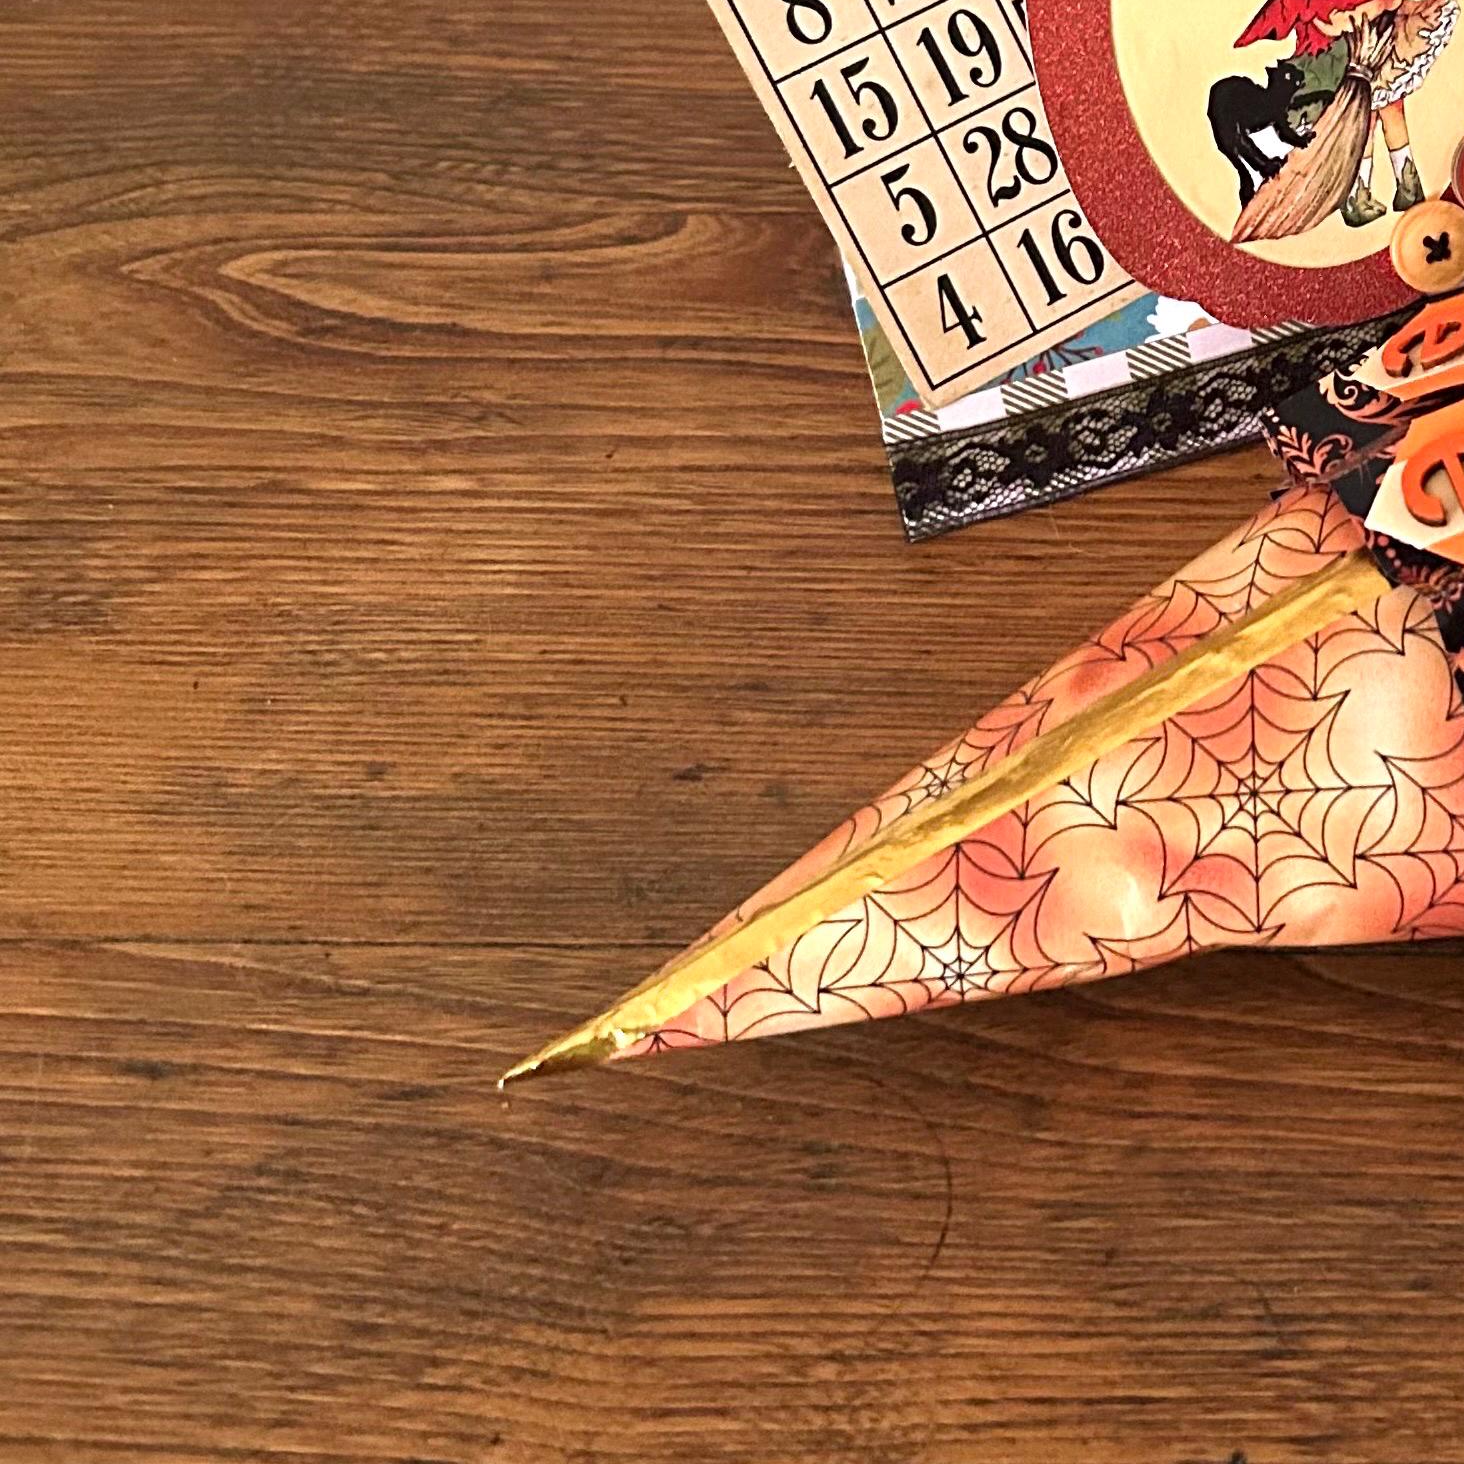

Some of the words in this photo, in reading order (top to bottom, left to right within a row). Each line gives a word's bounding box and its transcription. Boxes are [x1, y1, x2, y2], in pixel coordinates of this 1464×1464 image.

[810, 57, 901, 160] 15
[916, 10, 1002, 107] 19
[880, 163, 938, 247] 5
[963, 107, 1058, 208] 28
[937, 273, 985, 351] 4
[1016, 209, 1103, 308] 16
